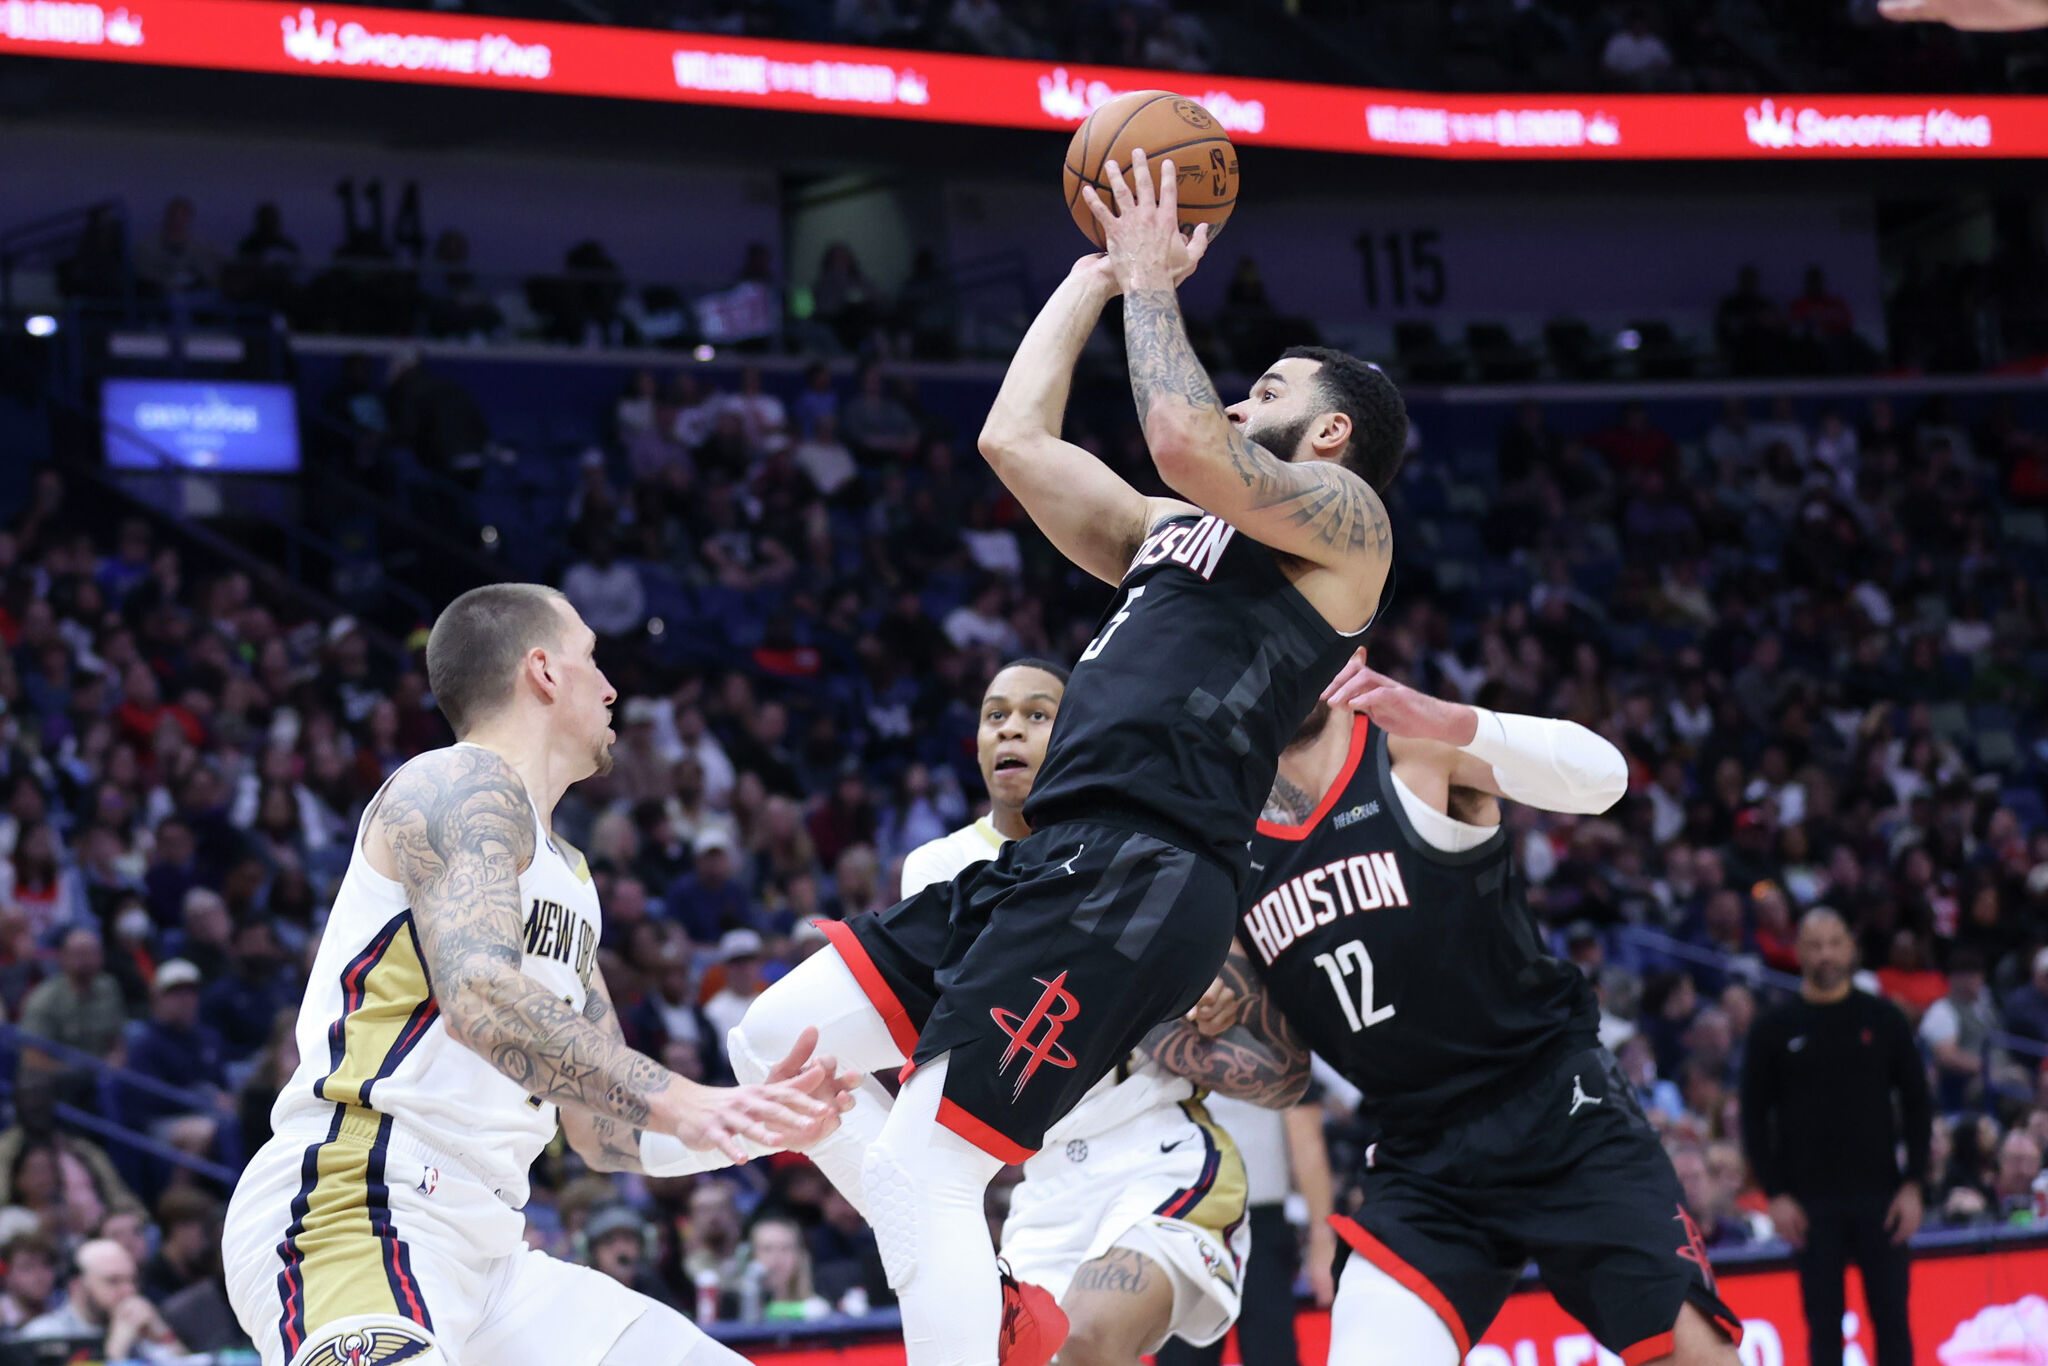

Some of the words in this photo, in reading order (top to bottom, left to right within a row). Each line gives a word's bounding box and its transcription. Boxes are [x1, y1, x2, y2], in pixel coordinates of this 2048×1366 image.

[1354, 231, 1446, 308] 115
[523, 899, 577, 965] NEW
[1243, 851, 1410, 967] HOUSTON
[1313, 939, 1396, 1033] 12
